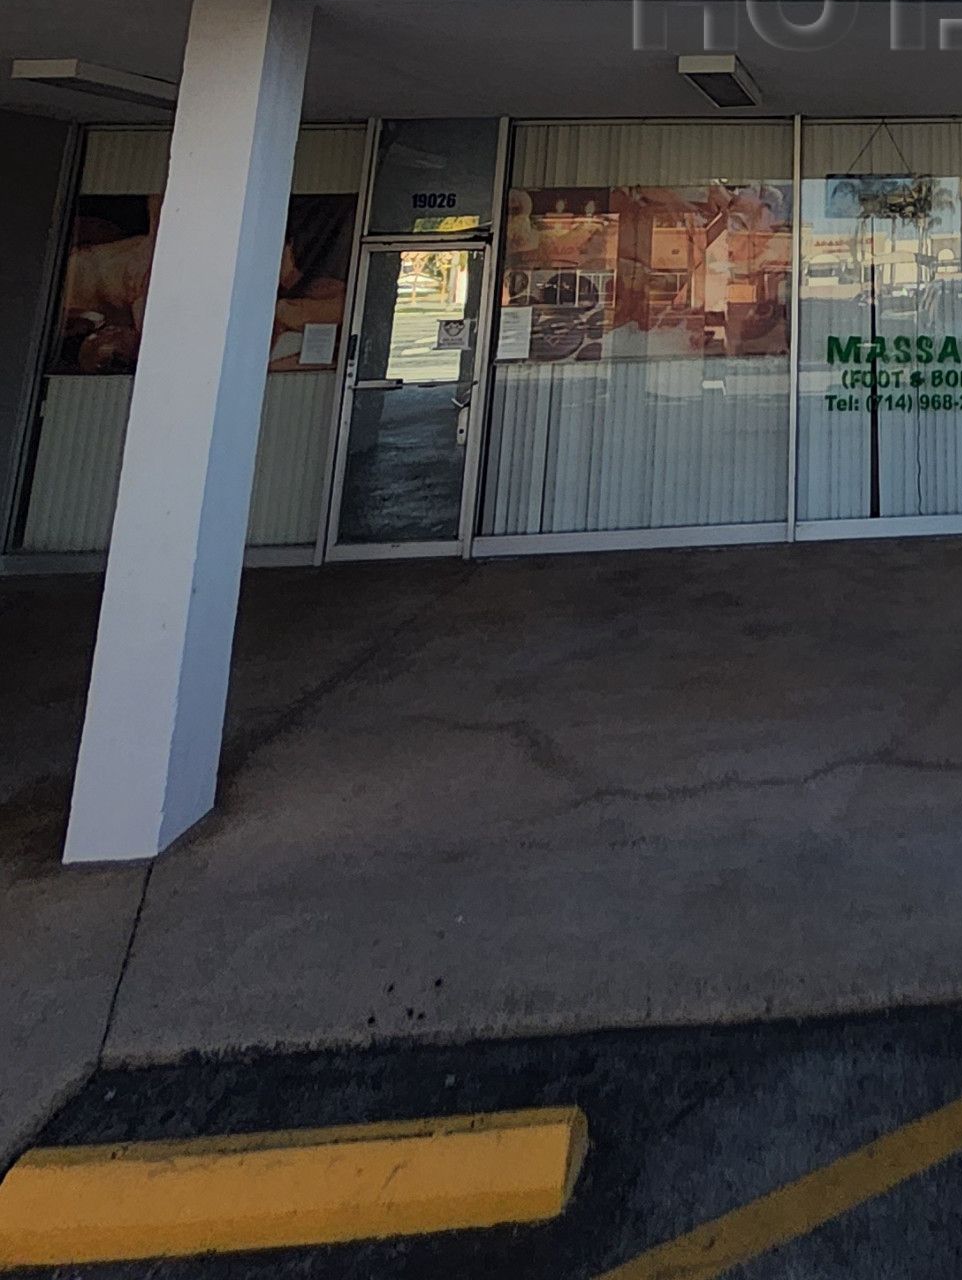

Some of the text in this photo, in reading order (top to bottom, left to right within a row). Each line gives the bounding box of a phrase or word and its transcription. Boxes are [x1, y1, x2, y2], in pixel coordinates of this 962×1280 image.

[411, 193, 457, 209] 19026
[841, 370, 904, 389] (FOOT
[825, 394, 860, 412] Tel:
[865, 394, 913, 413] (714)
